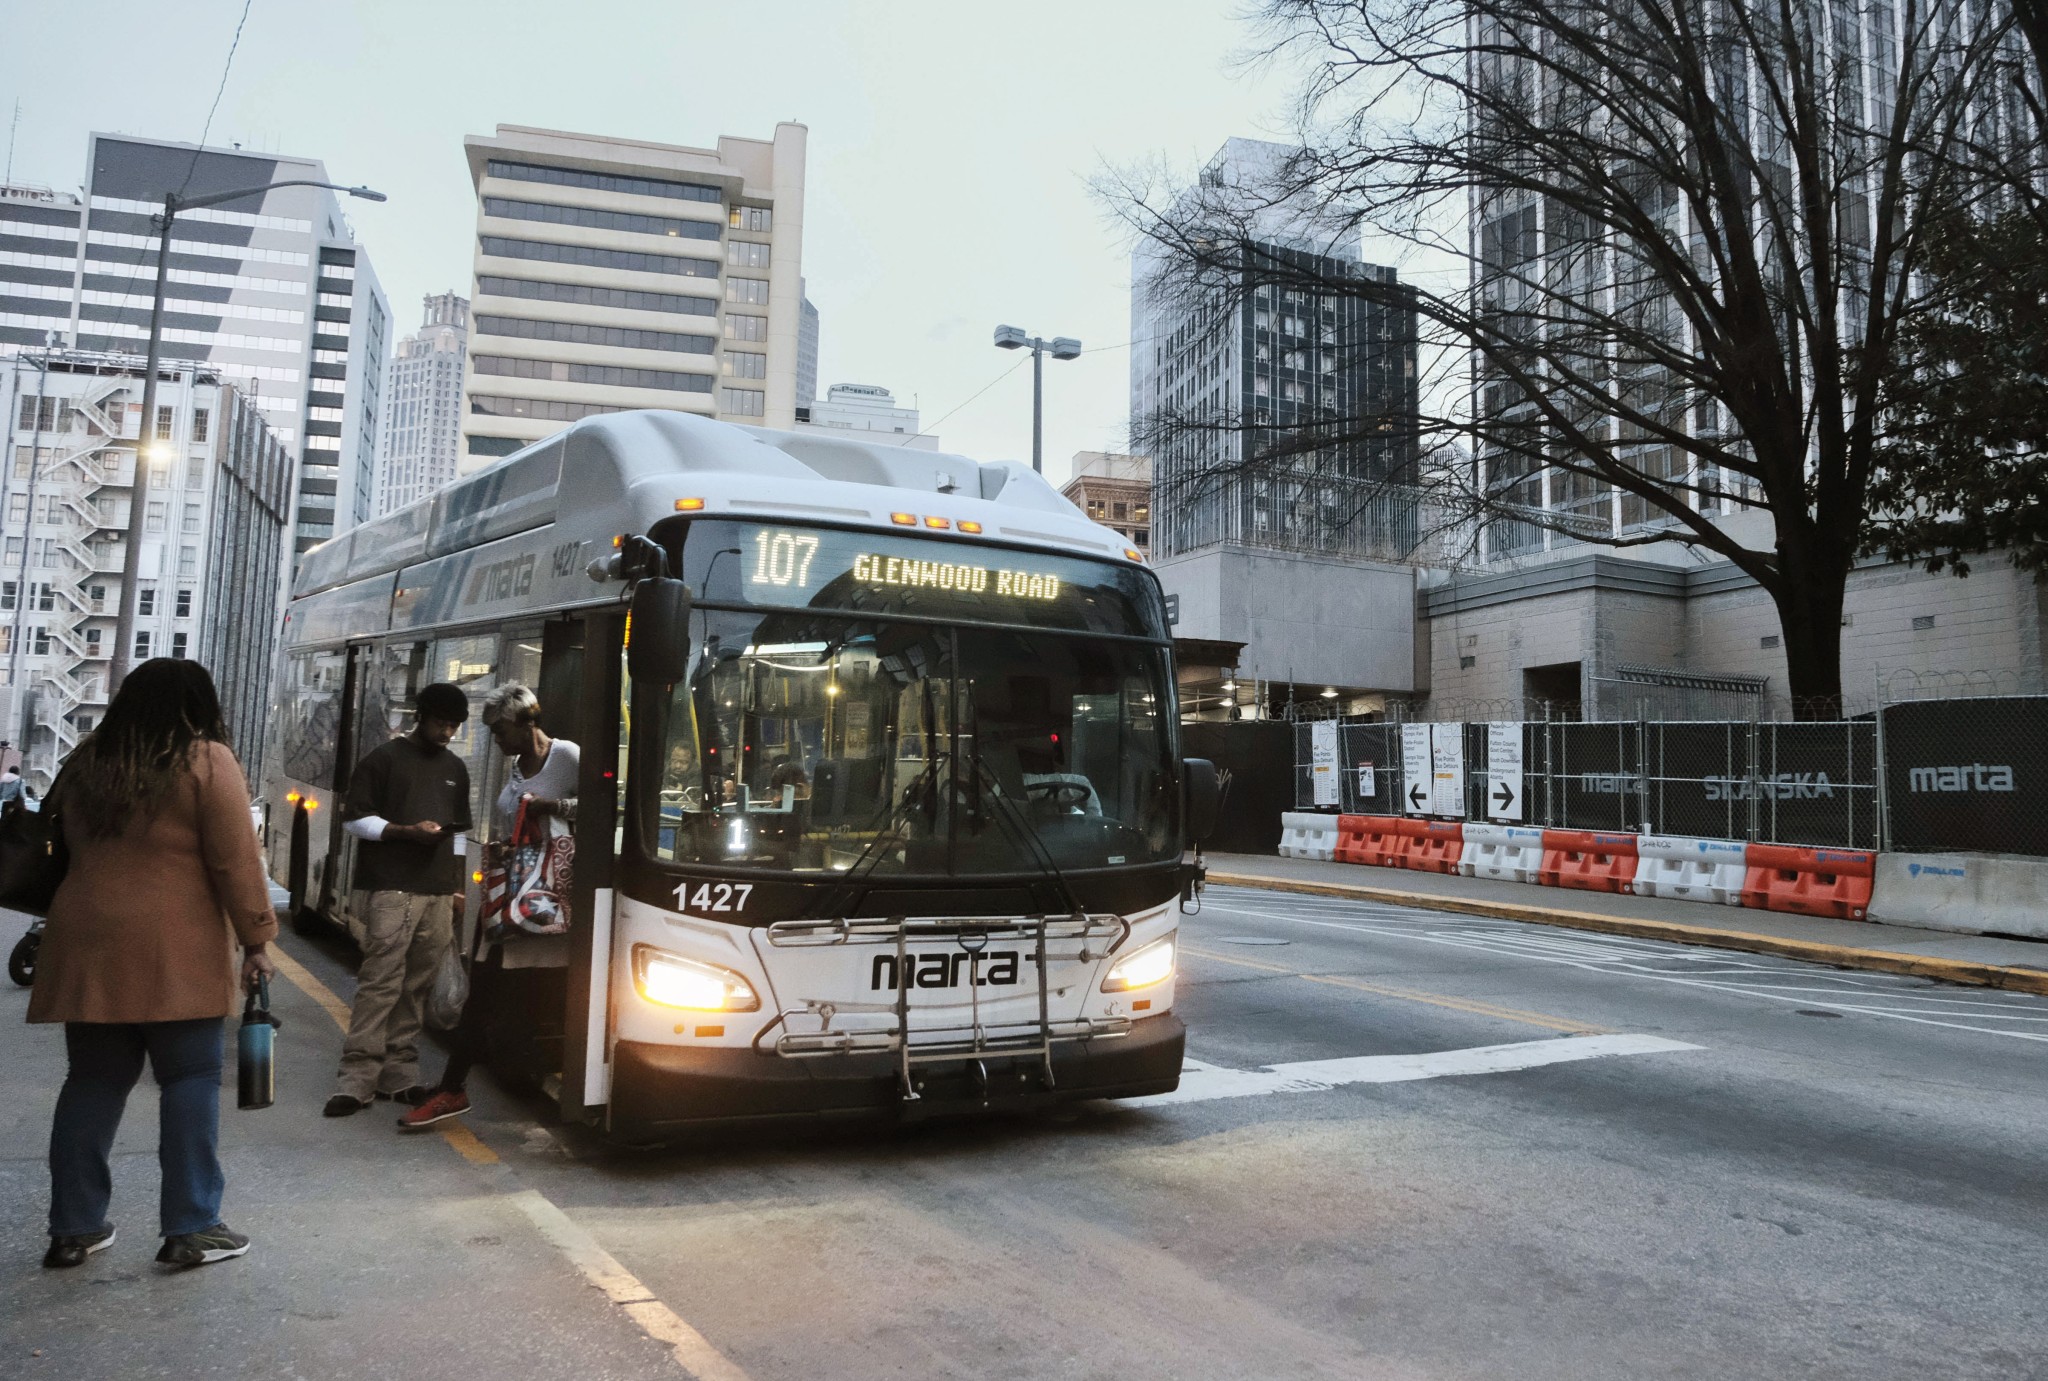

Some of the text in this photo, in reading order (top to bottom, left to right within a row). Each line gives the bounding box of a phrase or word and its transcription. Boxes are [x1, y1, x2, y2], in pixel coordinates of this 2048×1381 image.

[552, 542, 580, 578] 1427
[752, 531, 819, 587] 107
[485, 553, 536, 602] marta
[853, 553, 1059, 600] GLENWOOD ROAD
[1581, 772, 1645, 794] marta
[1704, 772, 1834, 800] SKANSKA
[1909, 763, 2014, 793] marta
[728, 819, 745, 850] 1
[672, 883, 754, 912] 1427
[872, 951, 1019, 990] marta
